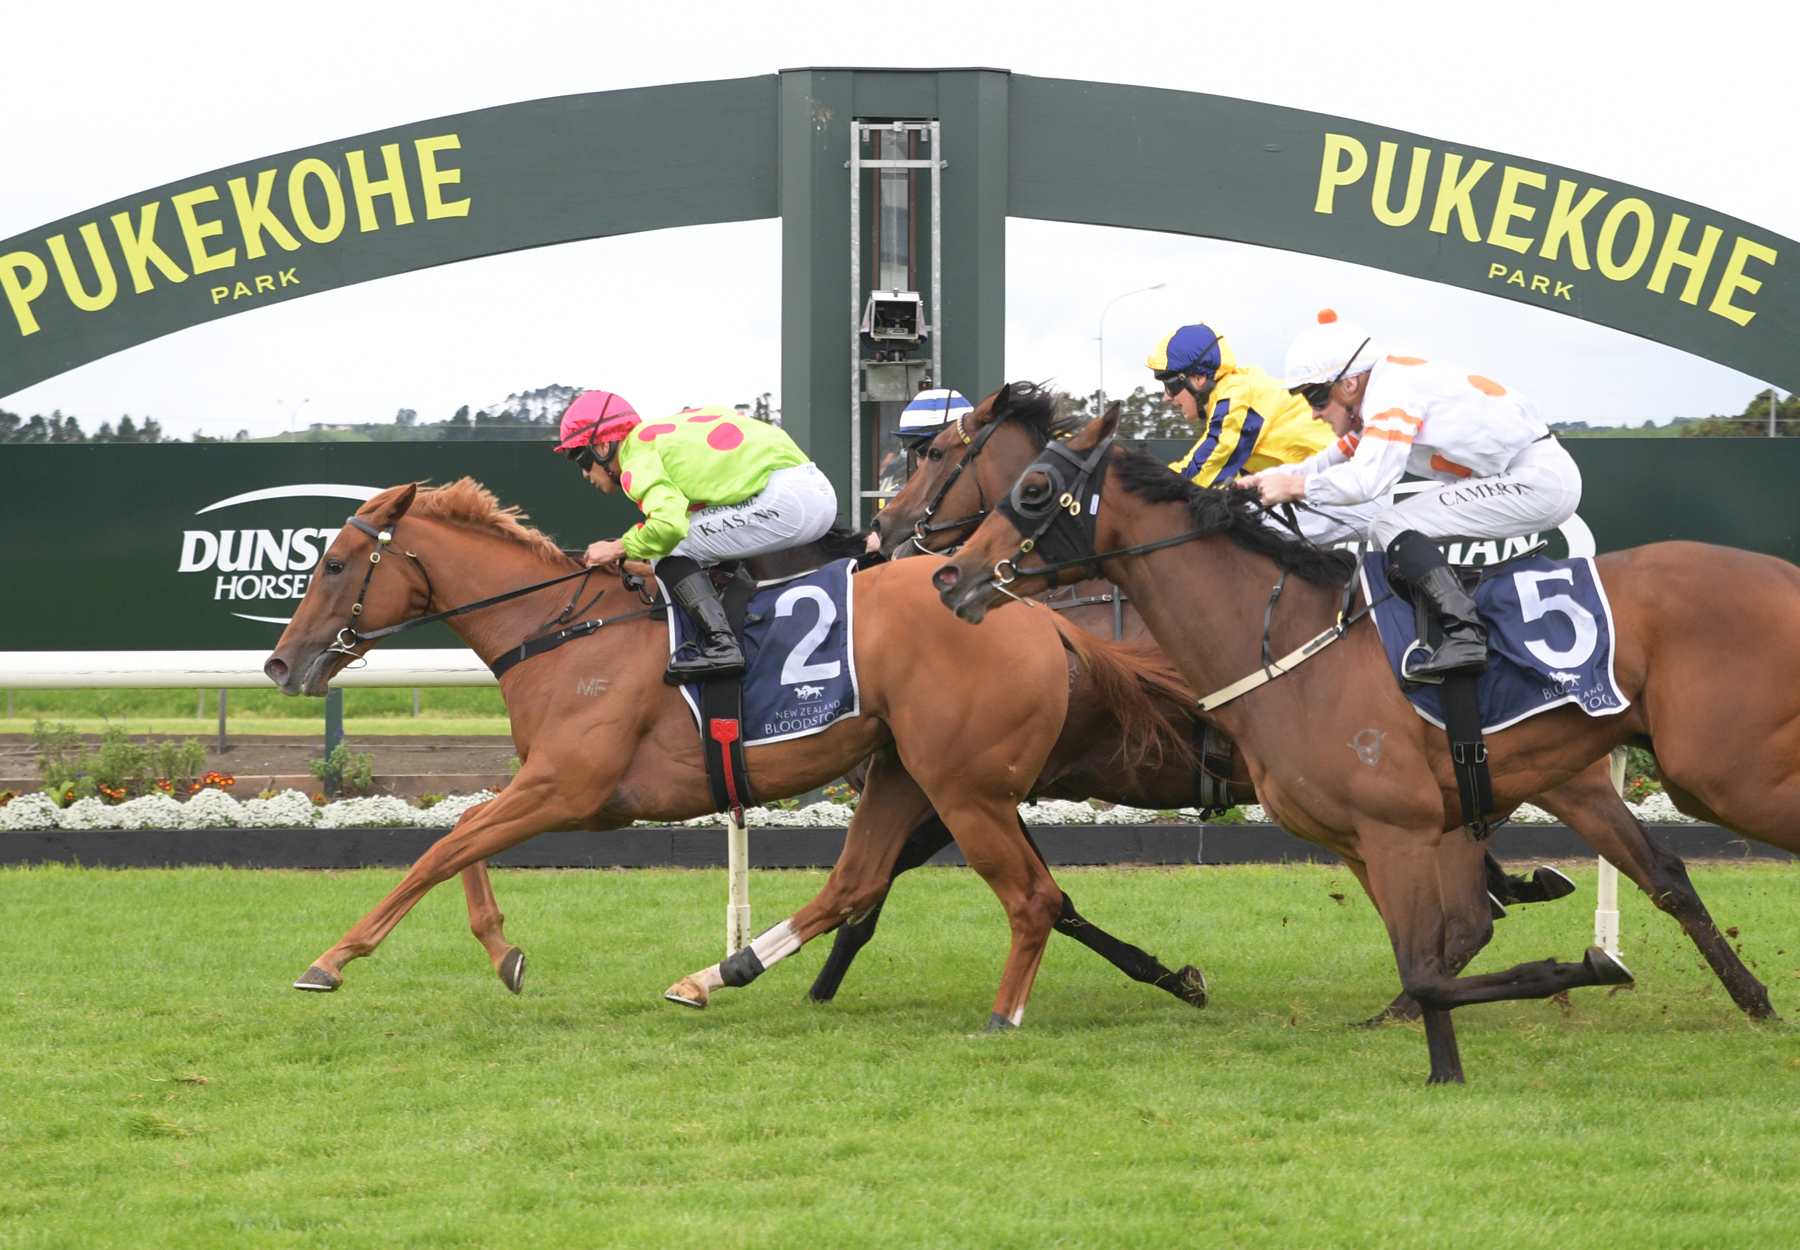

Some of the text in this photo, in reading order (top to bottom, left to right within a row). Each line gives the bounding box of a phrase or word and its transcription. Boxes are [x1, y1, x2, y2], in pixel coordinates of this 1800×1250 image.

[0, 133, 472, 337] PUKEKOHE
[1314, 132, 1778, 327] PUKEKOHE
[210, 267, 301, 305] PARK
[1488, 262, 1574, 301] PARK
[177, 527, 343, 573] DUNST
[213, 574, 314, 600] HORSE
[774, 584, 841, 686] 2
[1512, 567, 1598, 669] 5
[775, 699, 841, 720] NEW ZEALAND
